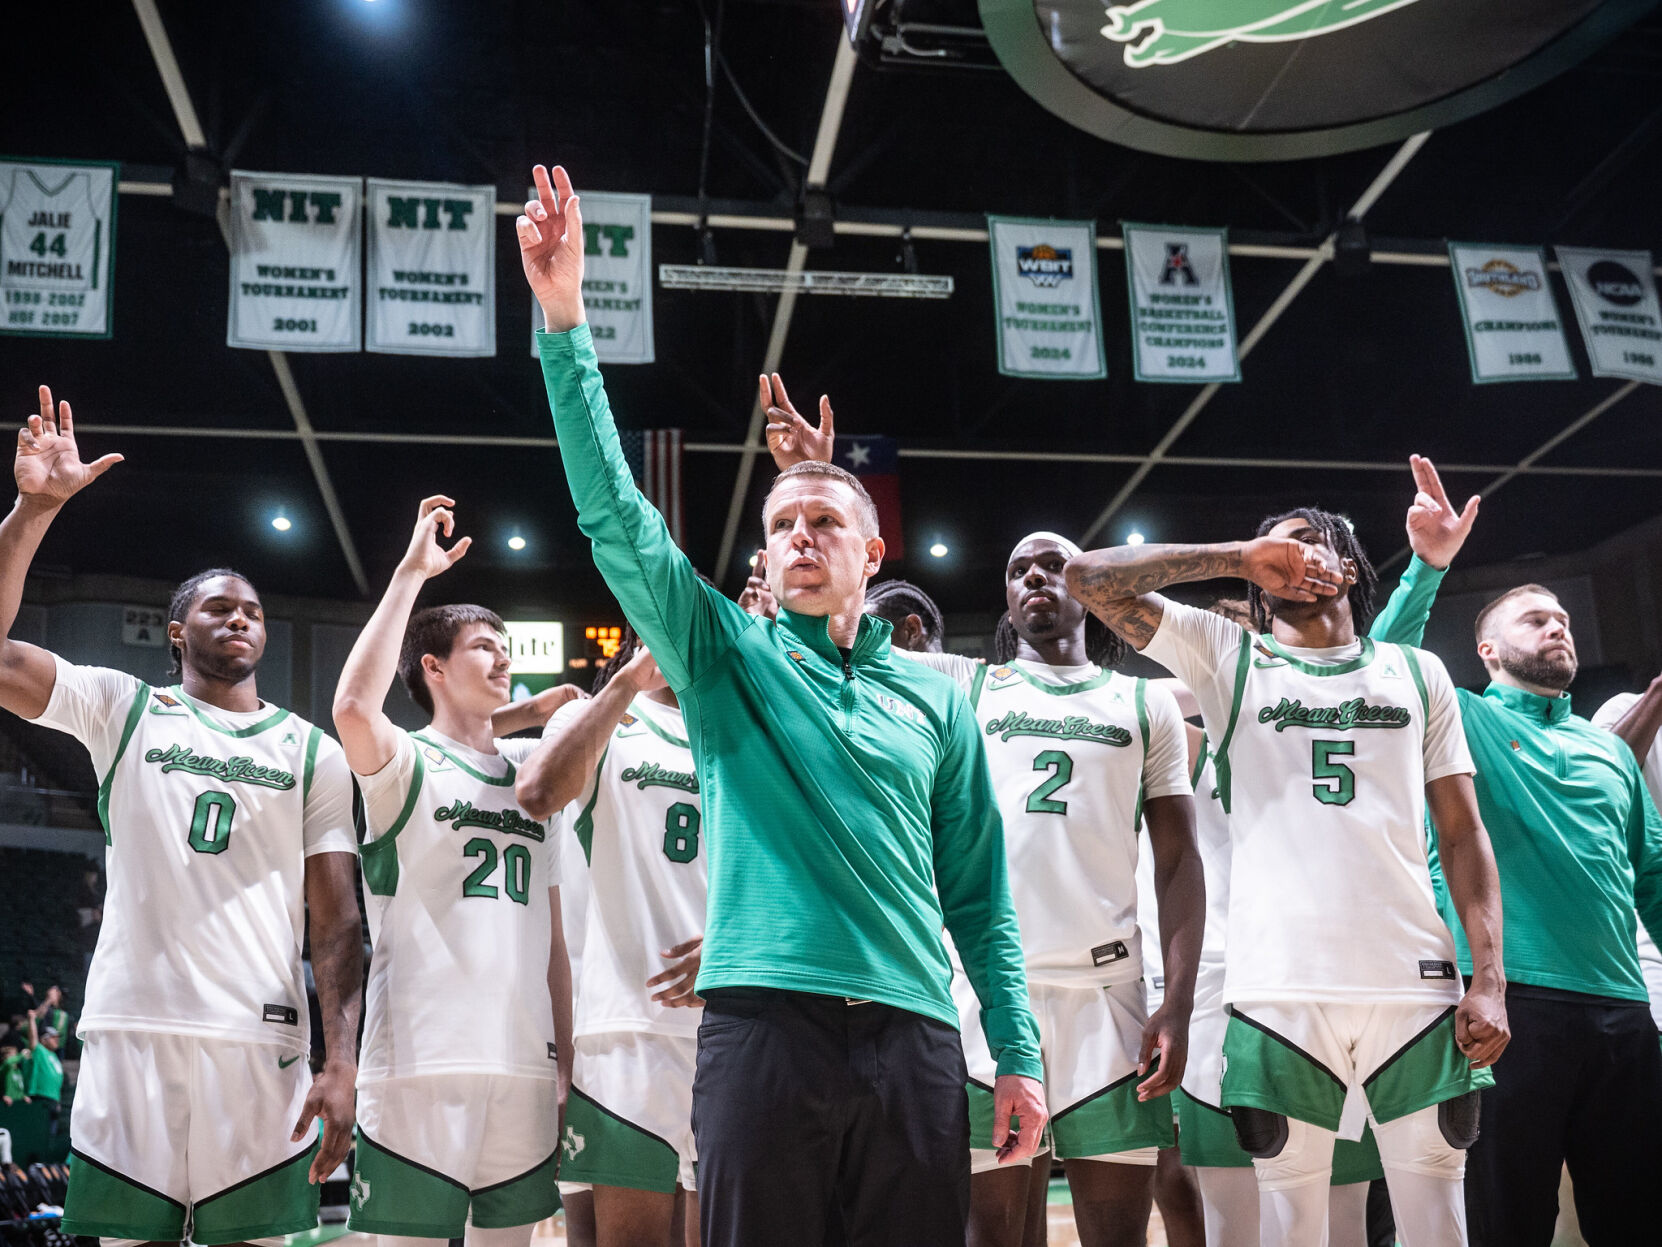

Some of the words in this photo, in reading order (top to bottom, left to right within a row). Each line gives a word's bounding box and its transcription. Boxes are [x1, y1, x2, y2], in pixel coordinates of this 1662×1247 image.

[253, 188, 341, 225] NIT
[387, 197, 473, 232] NIT
[28, 211, 71, 229] JALIE
[30, 231, 67, 257] 44
[583, 223, 635, 257] IT
[8, 260, 83, 280] MITCHELL
[257, 265, 336, 282] WOMEN'S
[392, 269, 469, 286] WOMEN'S
[241, 283, 349, 300] TOURNAMENT
[379, 287, 484, 305] TOURNAMENT
[582, 280, 628, 294] MEN'S
[1015, 301, 1081, 316] WOMEN'S
[274, 318, 318, 333] 2001
[408, 322, 454, 338] 2002
[1025, 749, 1074, 816] 2
[1312, 739, 1356, 807] 5
[187, 789, 237, 855] 0
[662, 801, 702, 864] 8
[462, 837, 532, 906] 20
